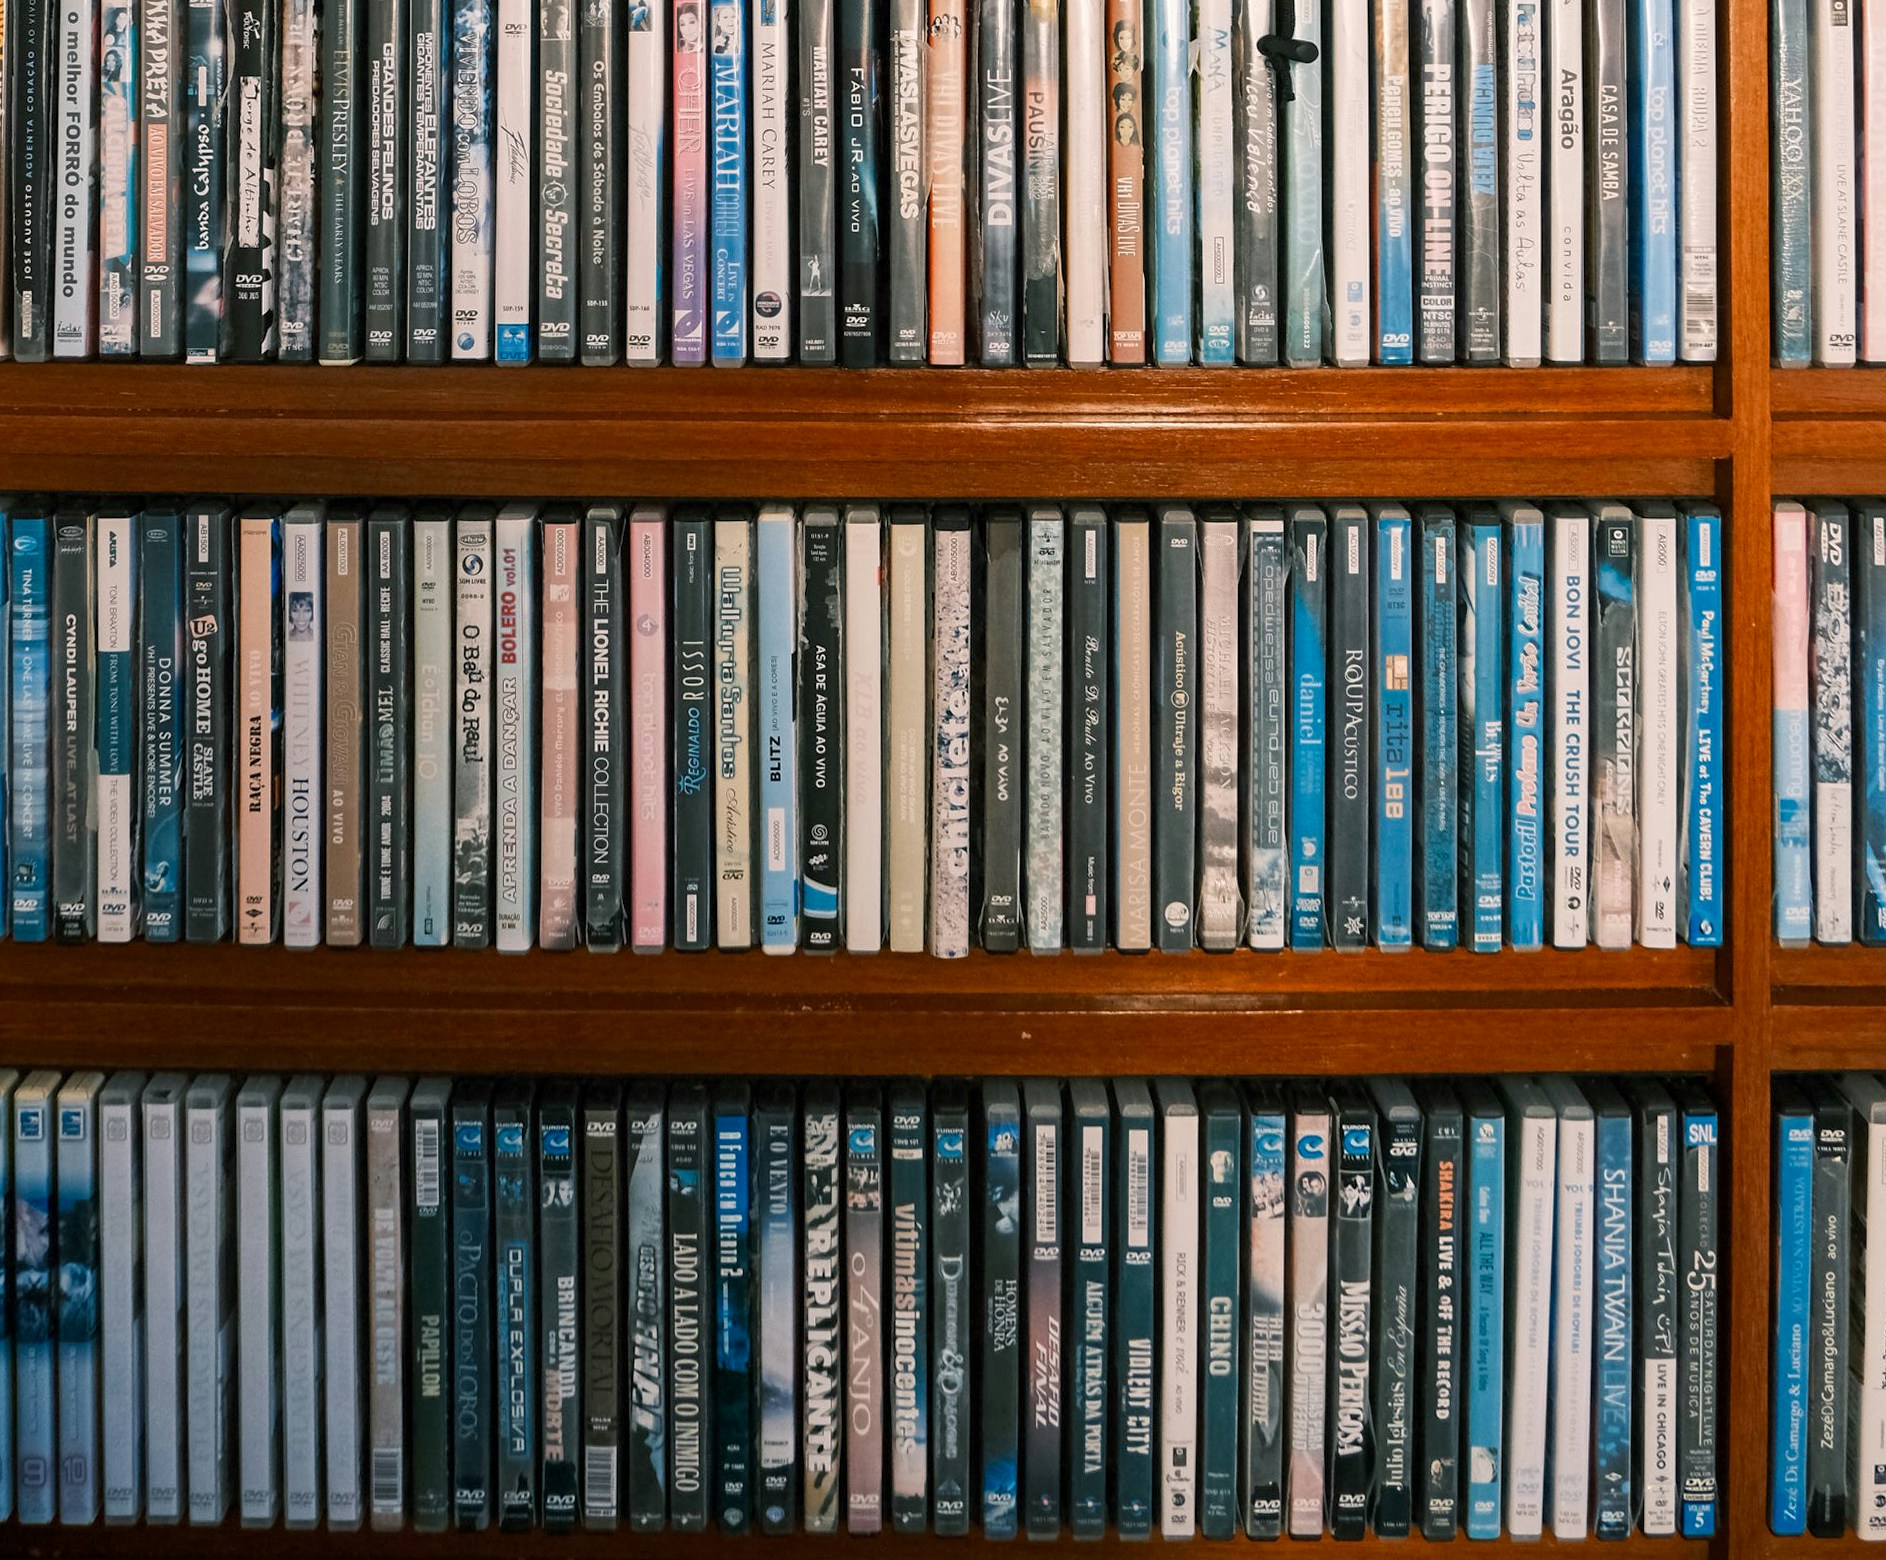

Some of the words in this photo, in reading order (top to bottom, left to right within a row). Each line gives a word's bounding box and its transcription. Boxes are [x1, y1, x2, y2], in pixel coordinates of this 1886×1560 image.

[67, 12, 81, 24] o
[66, 31, 82, 104] melhor
[145, 48, 168, 119] PRETA
[332, 49, 348, 98] ELVIS
[382, 42, 395, 136] GRANDES
[593, 61, 604, 79] Os
[762, 43, 776, 120] MARIAH
[371, 60, 380, 148] PREDADORES
[545, 70, 567, 177] Sociedade
[593, 84, 604, 137] Embalos
[1425, 64, 1450, 163] PERIGO
[1558, 69, 1578, 150] Aragão
[1601, 85, 1617, 123] CASA
[66, 111, 83, 187] FORRÓ
[332, 99, 349, 174] PRESLEY
[593, 142, 604, 158] de
[762, 129, 776, 189] CAREY
[1602, 128, 1617, 147] DE
[371, 150, 380, 225] SELVAGENS
[381, 141, 395, 220] FELINOS
[593, 163, 605, 211] Sábado
[1117, 177, 1132, 199] VH1
[1602, 152, 1618, 200] SAMBA
[64, 194, 79, 219] do
[593, 217, 605, 225] à
[1117, 202, 1139, 233] DIVAS
[1425, 169, 1451, 274] ON-LINE
[63, 227, 78, 298] mundo
[546, 210, 568, 299] Secreta
[593, 230, 604, 265] Noite
[1118, 236, 1135, 256] LIVE
[1563, 226, 1573, 302] convida
[593, 580, 609, 614] THE
[1566, 575, 1580, 619] BON
[67, 614, 76, 664] CYNDI
[501, 591, 516, 663] BOLERO
[718, 567, 741, 683] Walkyria
[1566, 626, 1580, 670] JOVI
[1700, 611, 1714, 639] Paul
[593, 618, 609, 685] LIONEL
[814, 645, 826, 670] ASA
[66, 668, 76, 731] LAUPER
[158, 657, 172, 723] DONNA
[815, 675, 826, 690] DE
[1696, 643, 1714, 713] McCartney
[593, 690, 609, 752] RICHIE
[721, 687, 741, 779] Santos
[814, 694, 827, 734] ÁGUIA
[1299, 674, 1320, 744] daniel
[1566, 690, 1580, 725] THE
[158, 731, 172, 805] SUMMER
[770, 736, 781, 782] BLITZ
[815, 736, 826, 755] AO
[1565, 733, 1580, 795] CRUSH
[1699, 730, 1712, 762] LIVE
[815, 759, 826, 788] VIVO
[1699, 765, 1711, 779] at
[1699, 783, 1712, 805] The
[291, 778, 309, 892] HOUSTON
[593, 757, 609, 864] COLLECTION
[1565, 804, 1580, 856] TOUR
[1699, 808, 1712, 859] CAVERN
[1699, 863, 1712, 900] CLUB!
[1438, 1160, 1454, 1230] SHAKIRA
[1604, 1169, 1625, 1269] SHANIA
[673, 1233, 699, 1281] LADO
[1438, 1236, 1453, 1269] LIVE
[674, 1287, 698, 1300] A
[1437, 1294, 1453, 1320] OFF
[1439, 1275, 1453, 1289] &
[674, 1305, 699, 1354] LADO
[1209, 1296, 1232, 1376] CHINO
[1340, 1280, 1371, 1355] MISSÃO
[1437, 1326, 1451, 1354] THE
[1604, 1274, 1624, 1360] TWAIN
[421, 1315, 440, 1397] PAPILLON
[808, 1229, 831, 1473] REPLICANTE
[1128, 1339, 1151, 1408] VIOLENT
[675, 1359, 699, 1398] COM
[1435, 1360, 1451, 1420] RECORD
[676, 1403, 699, 1416] O
[1338, 1362, 1364, 1455] PERIGOSA
[676, 1421, 700, 1492] INIMIGO
[1127, 1416, 1150, 1455] CITY
